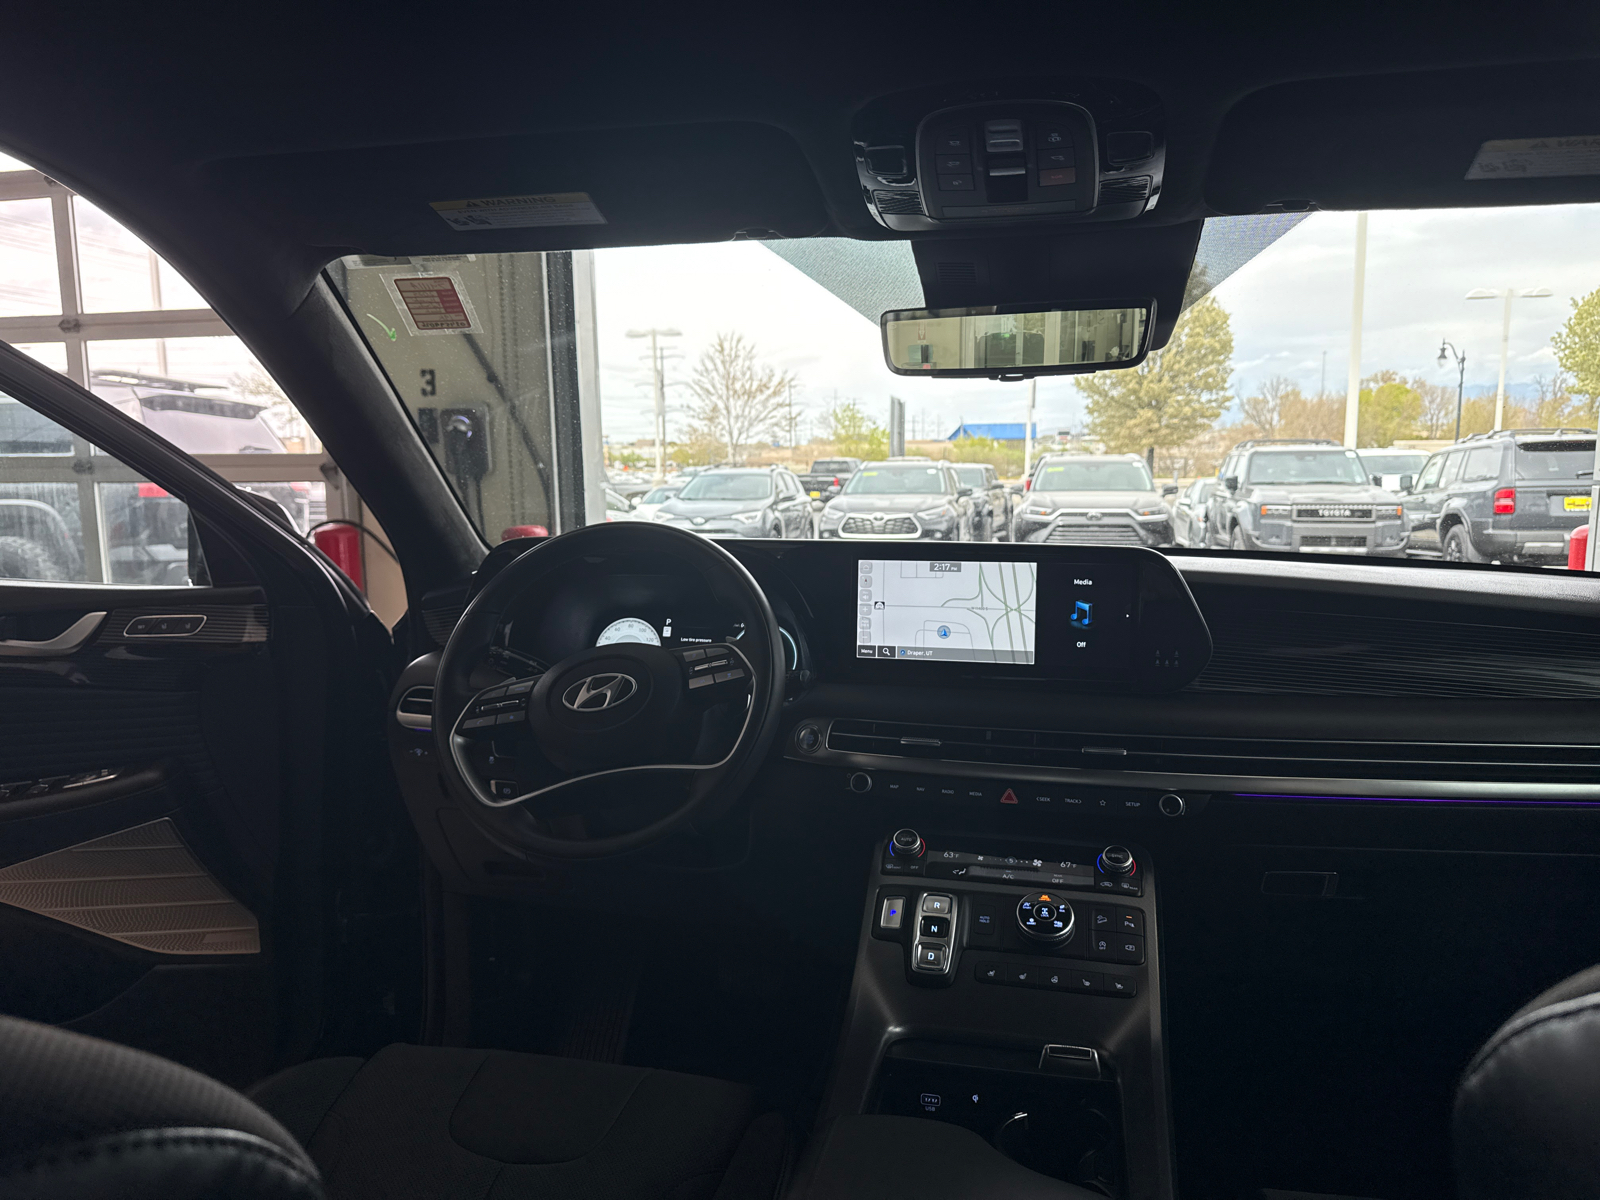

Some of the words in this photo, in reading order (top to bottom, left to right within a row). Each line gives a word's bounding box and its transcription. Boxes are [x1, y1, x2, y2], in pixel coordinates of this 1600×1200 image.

[480, 196, 556, 207] WARNING
[420, 368, 436, 397] 3
[1318, 509, 1351, 517] TOYOTA
[933, 563, 950, 571] 2:17
[1073, 578, 1093, 586] Media
[665, 618, 672, 626] P
[907, 649, 925, 657] Draper,
[933, 901, 941, 909] R
[889, 909, 897, 917] P
[930, 925, 938, 933] N
[927, 952, 935, 960] D
